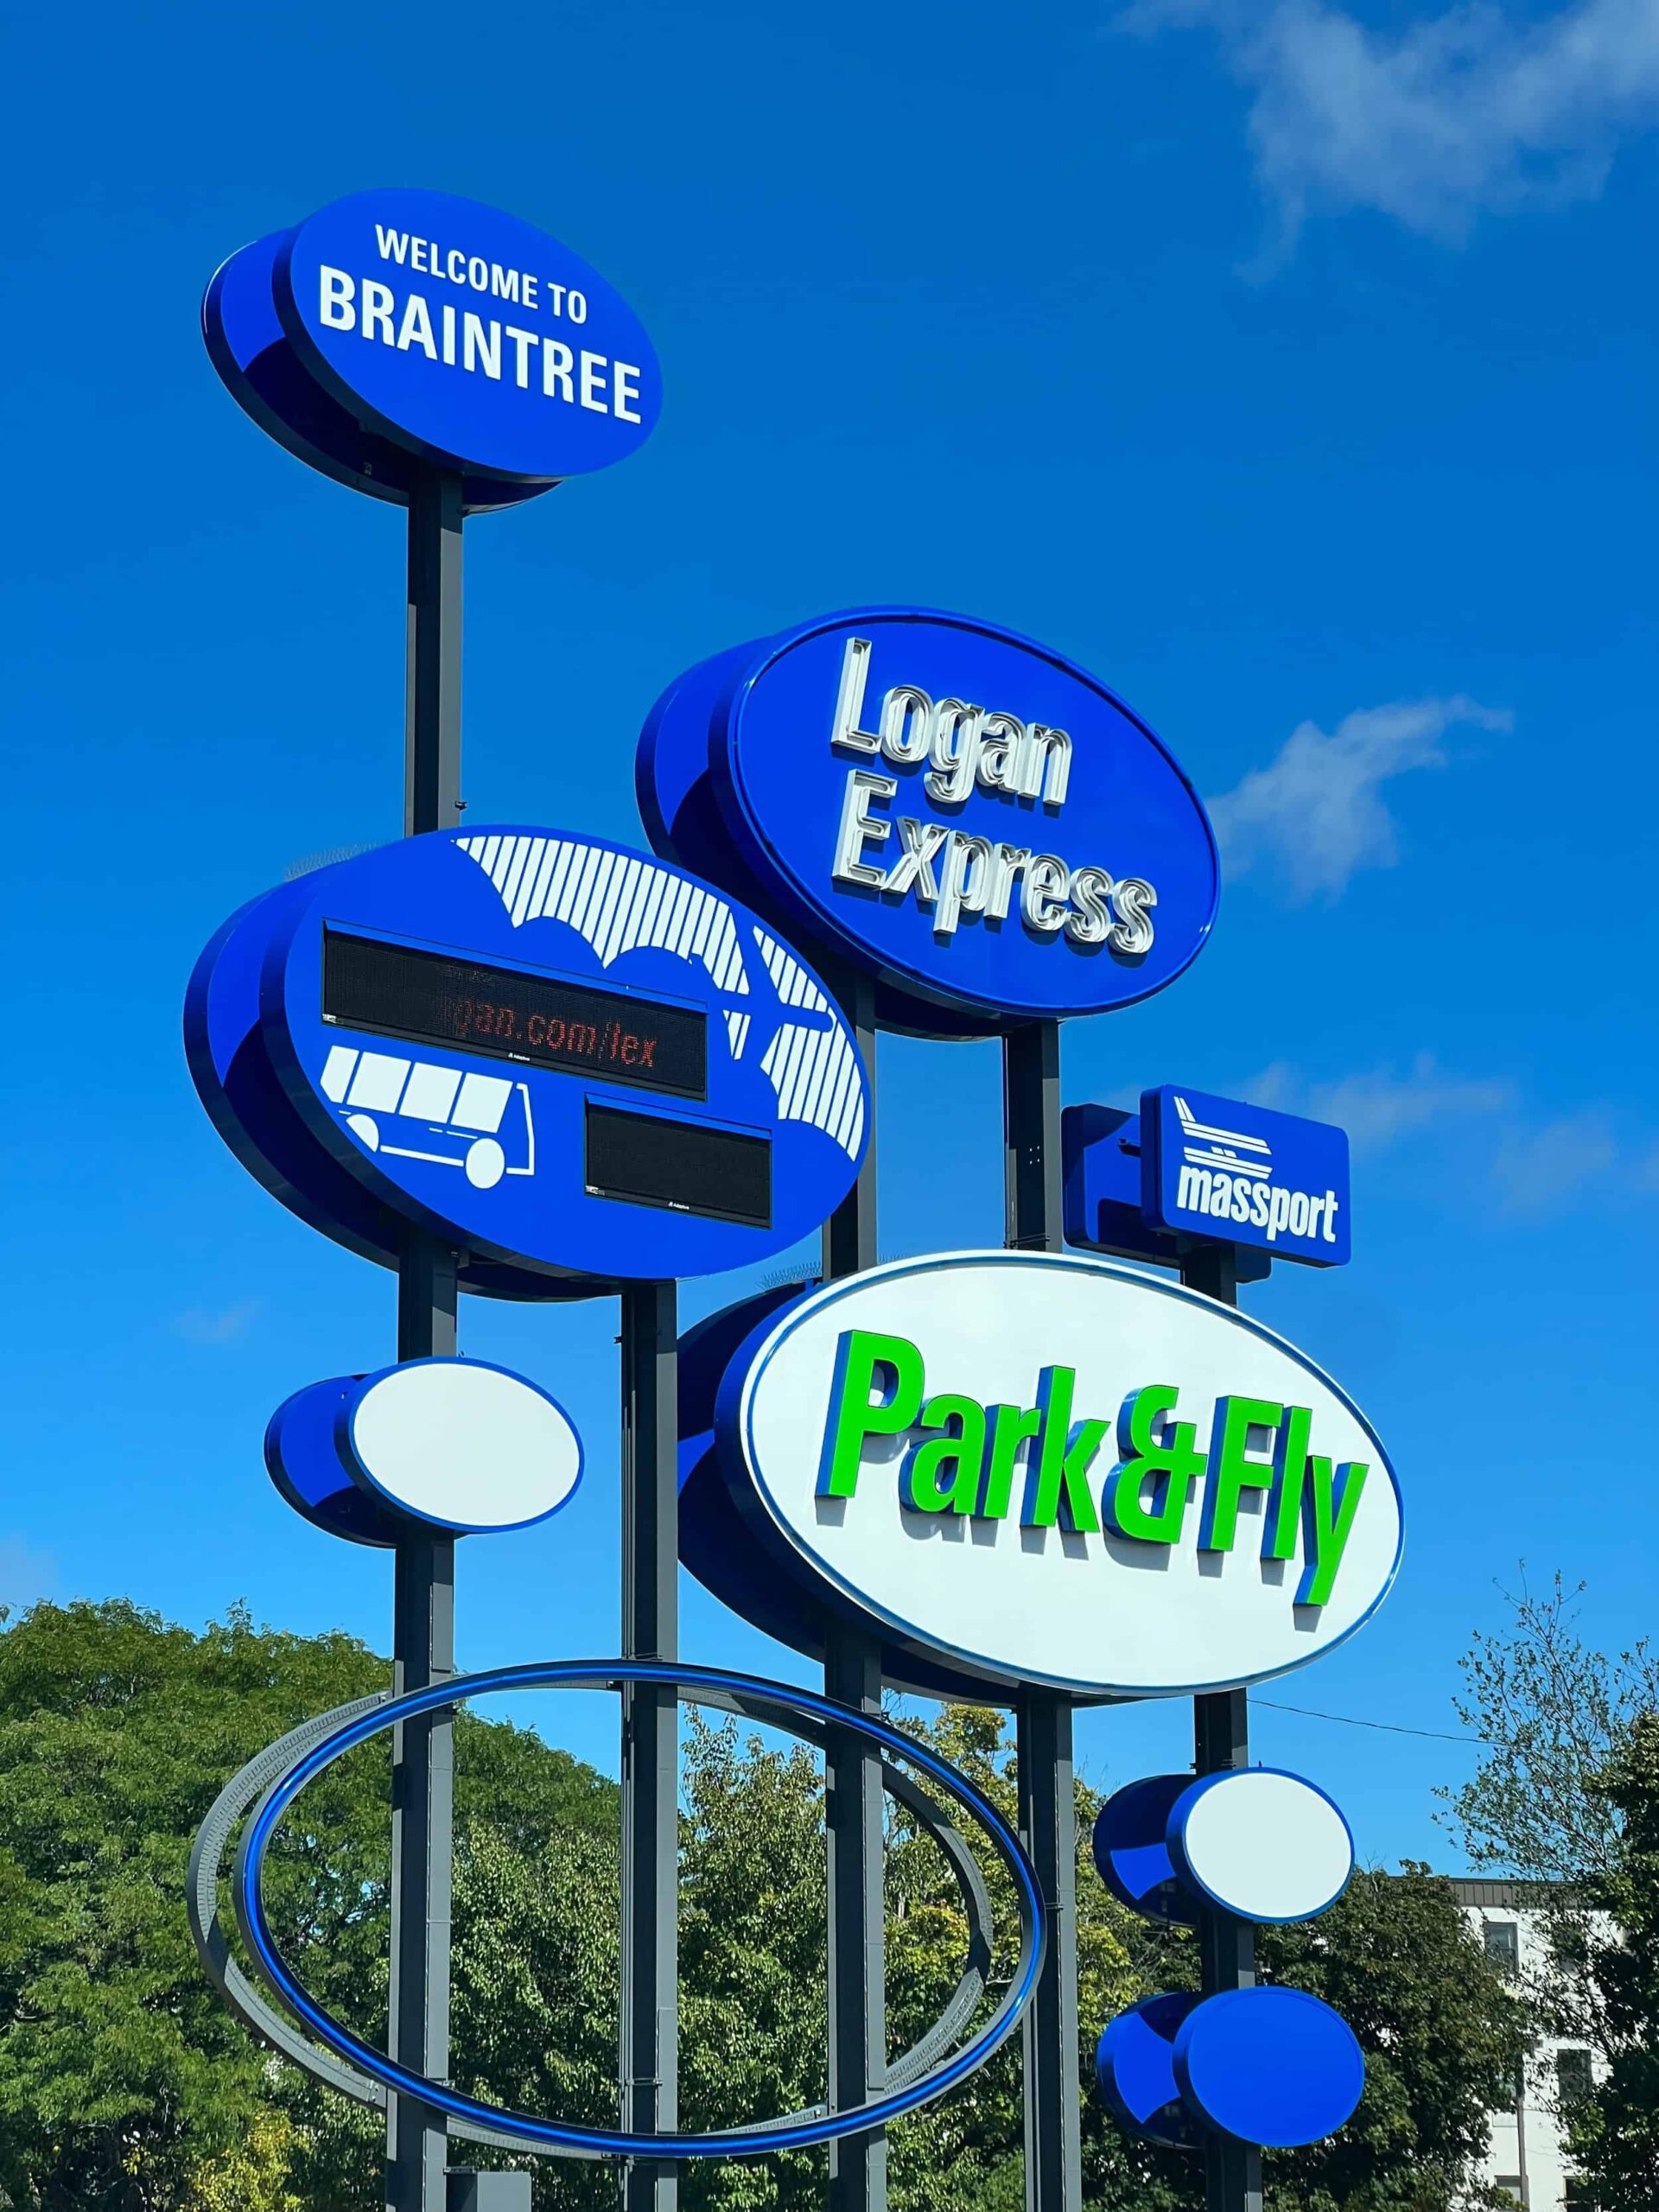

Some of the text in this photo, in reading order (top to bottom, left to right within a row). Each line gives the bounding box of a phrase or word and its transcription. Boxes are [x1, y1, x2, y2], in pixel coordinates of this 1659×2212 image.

[320, 264, 642, 425] BRAINTREE
[374, 223, 588, 325] WELCOME TO
[830, 636, 1073, 806] Logan
[831, 768, 1158, 954] Express
[1177, 1165, 1338, 1243] massport
